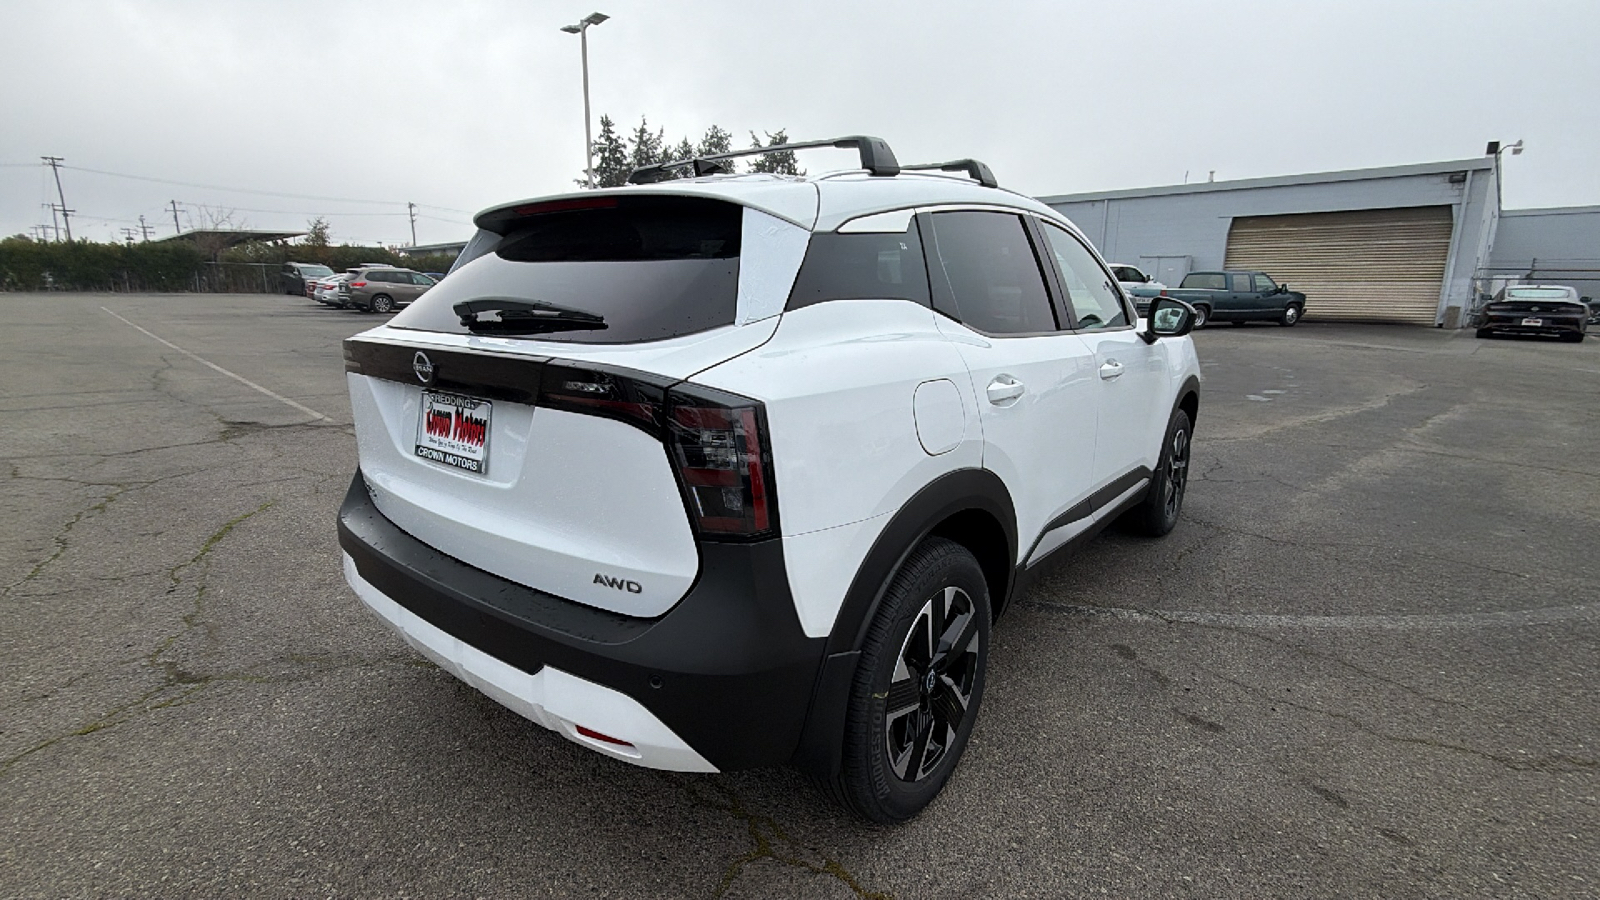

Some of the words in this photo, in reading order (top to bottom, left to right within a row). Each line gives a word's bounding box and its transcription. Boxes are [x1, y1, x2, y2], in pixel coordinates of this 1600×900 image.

[435, 394, 471, 408] REDDING
[426, 406, 452, 439] Crown
[453, 406, 487, 447] Motors
[418, 446, 444, 462] CROWN
[445, 454, 478, 471] MOTORS
[593, 573, 643, 594] AWD
